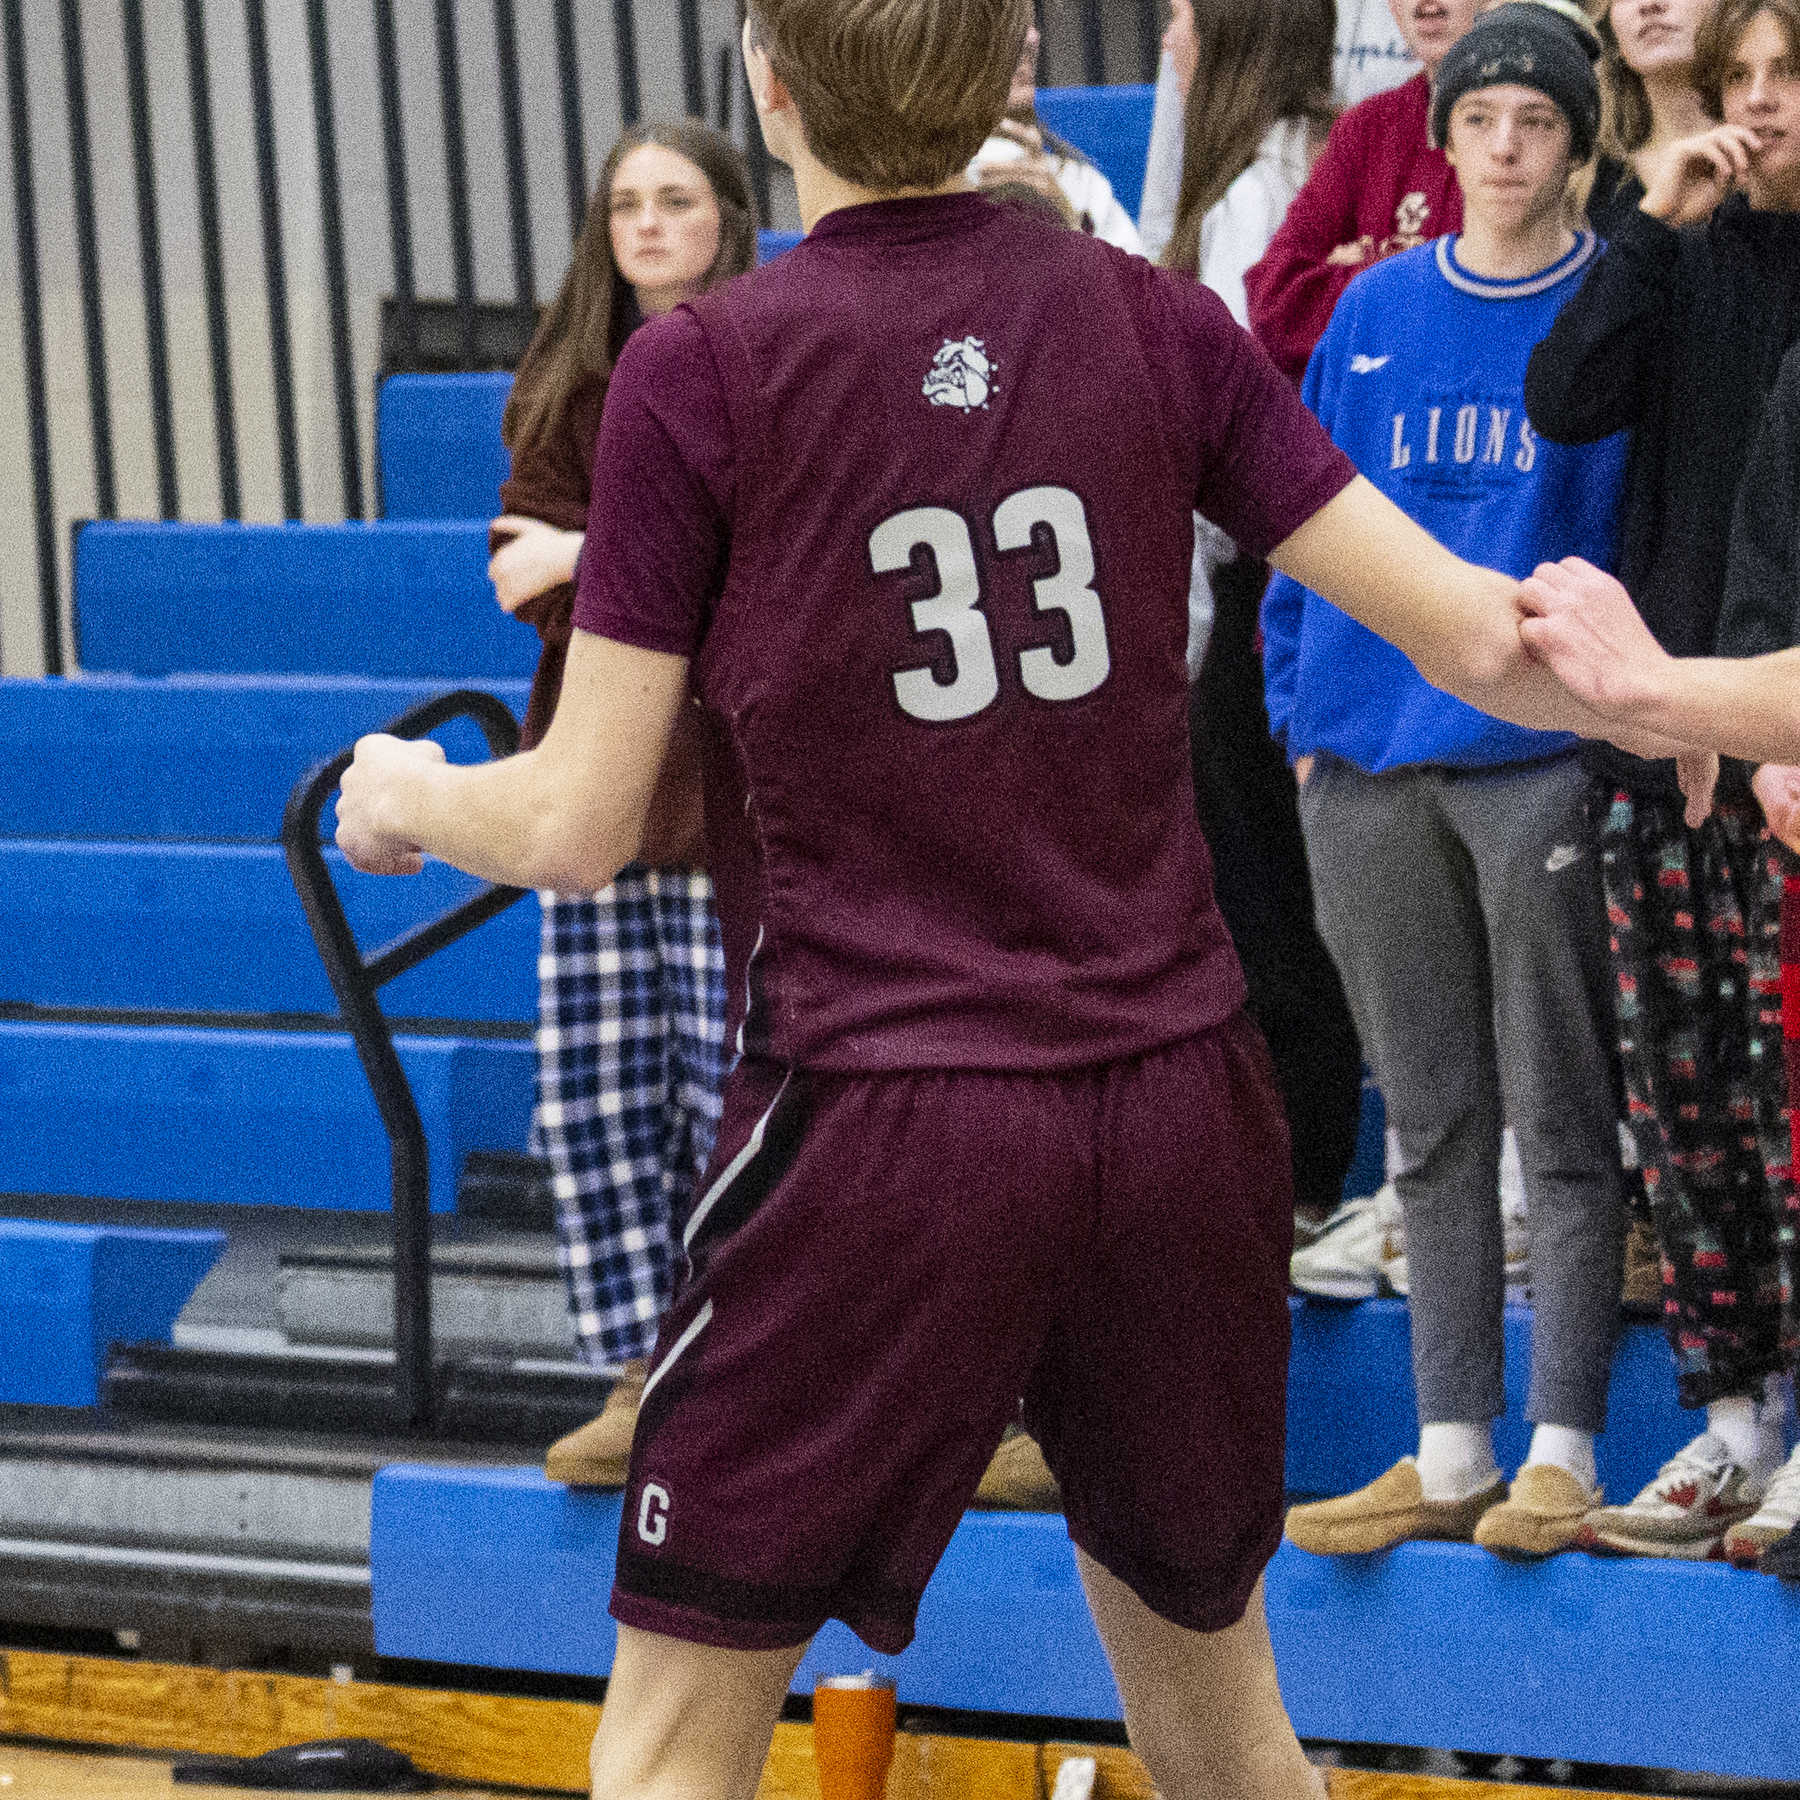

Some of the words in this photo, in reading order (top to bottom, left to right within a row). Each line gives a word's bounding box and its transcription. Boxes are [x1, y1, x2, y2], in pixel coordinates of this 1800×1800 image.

[1390, 404, 1537, 472] LIONS
[868, 486, 1111, 721] 33
[638, 1483, 670, 1546] G
